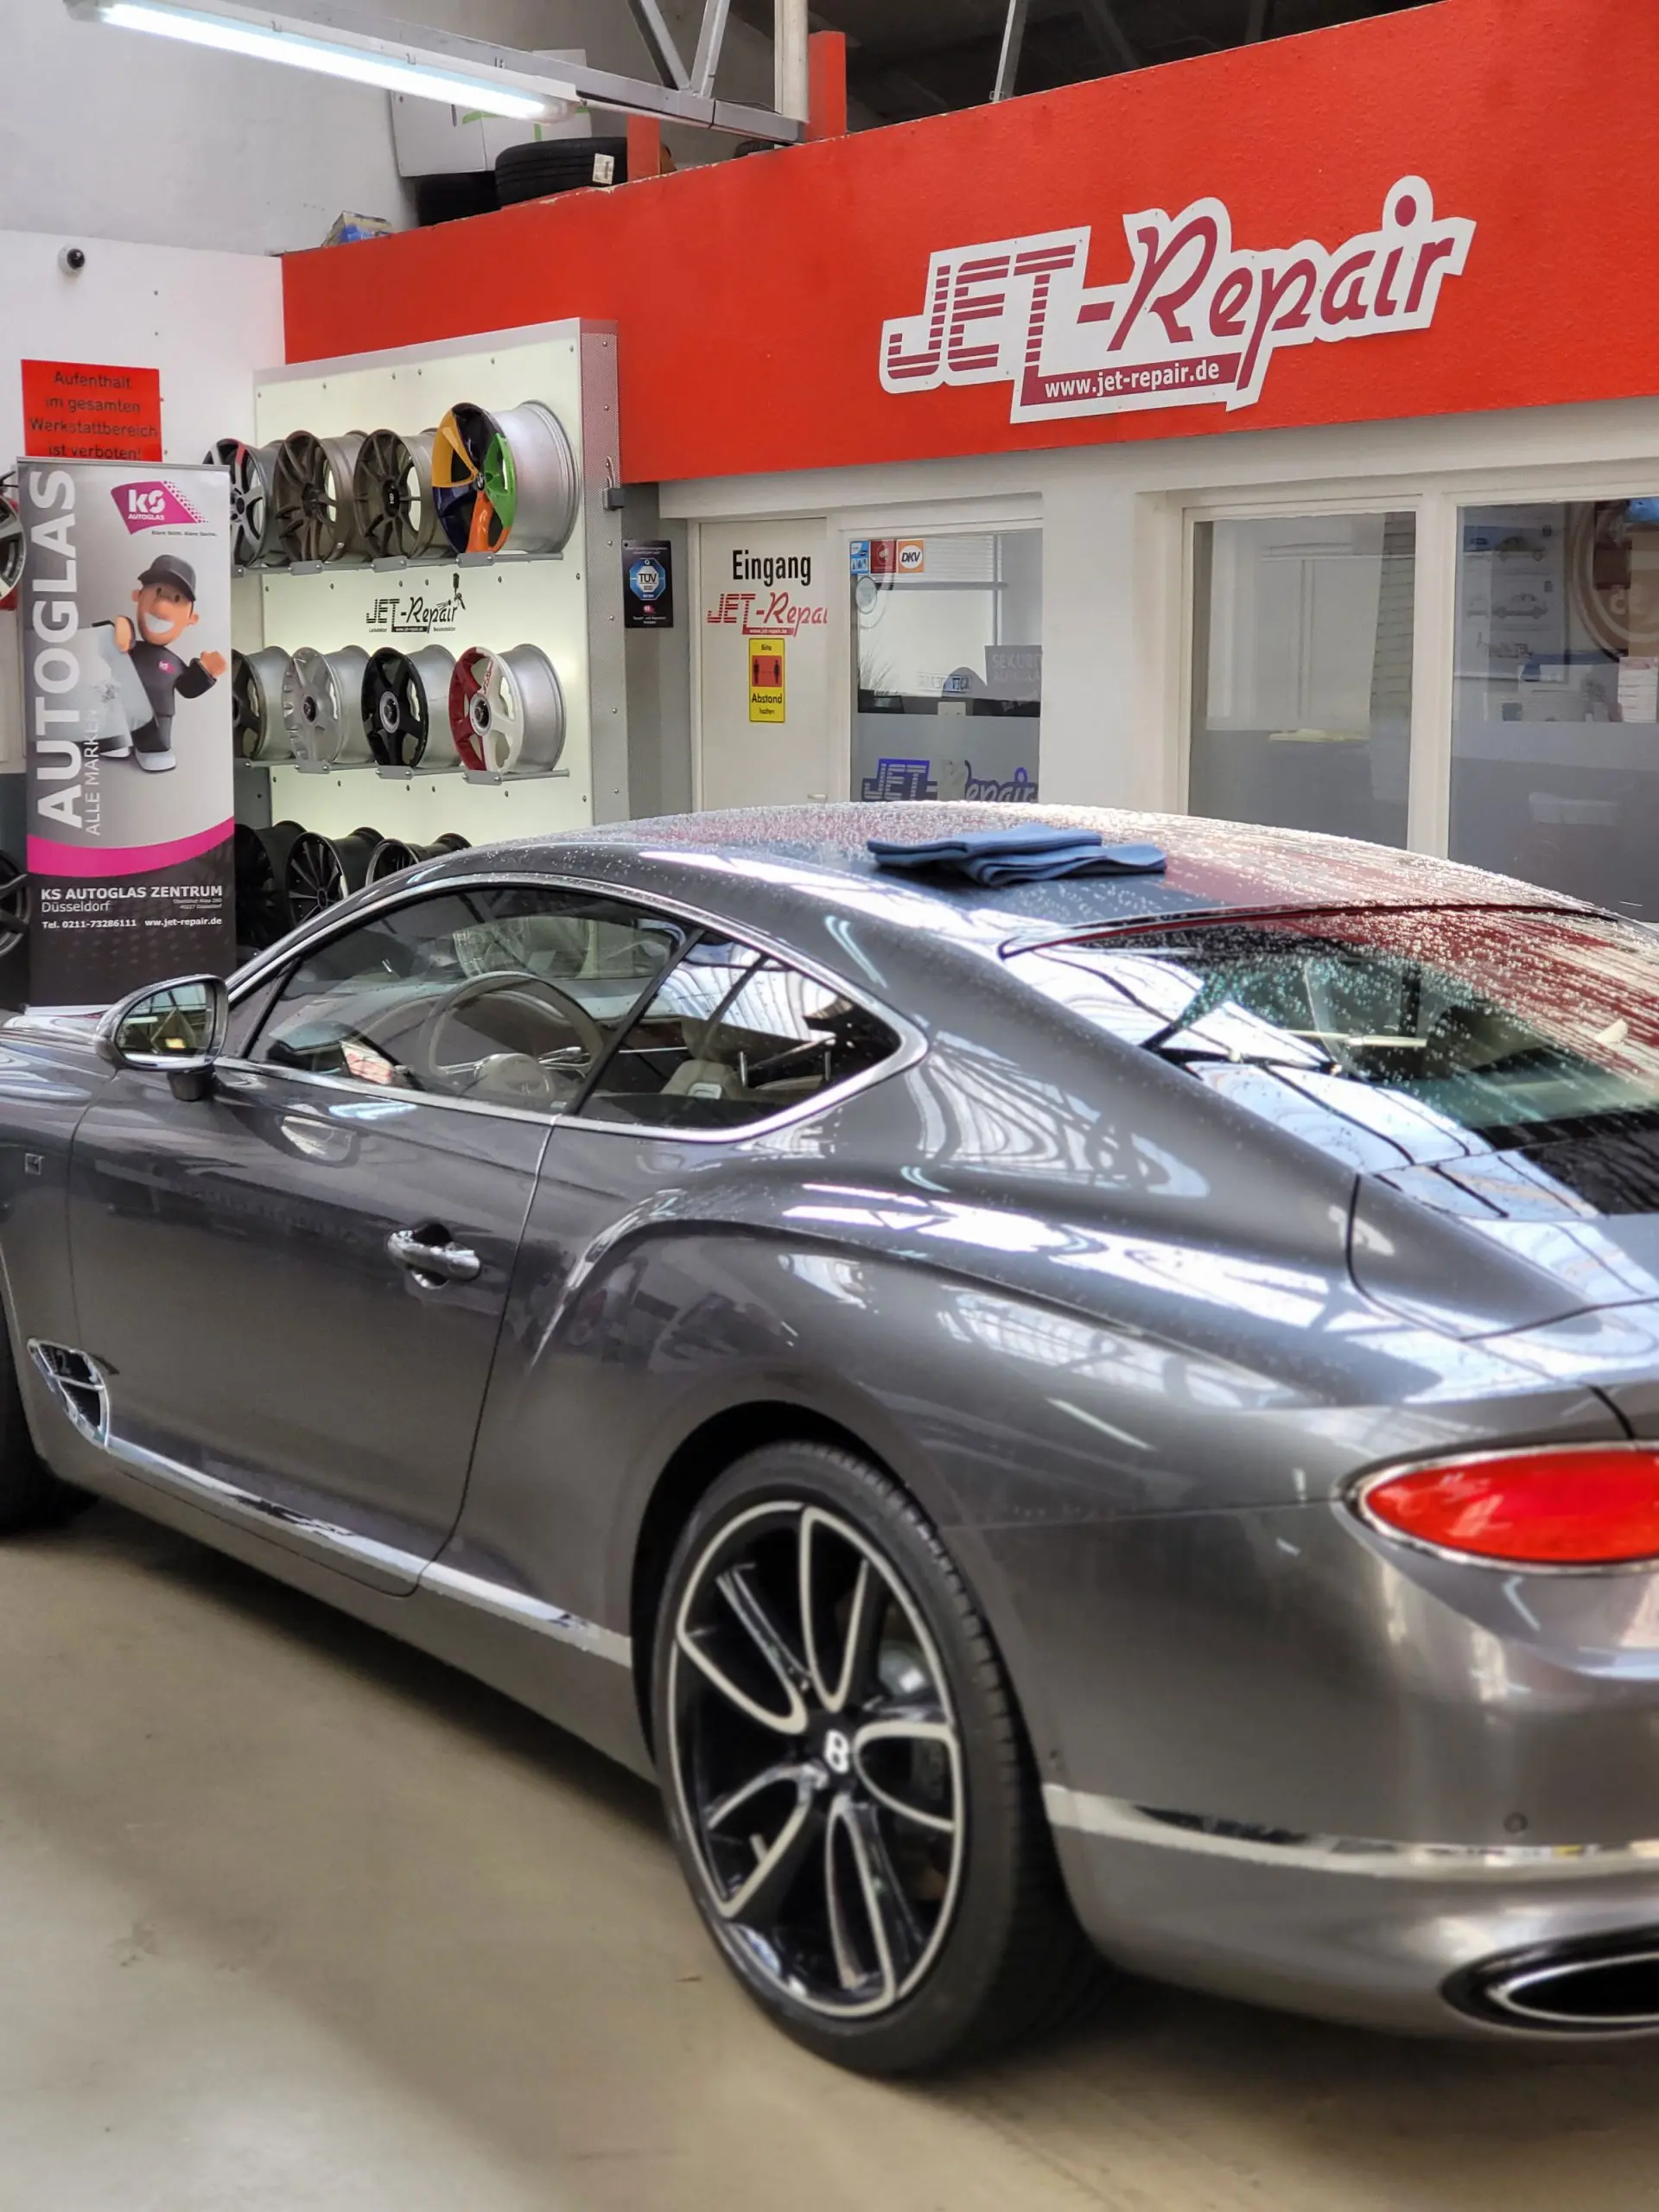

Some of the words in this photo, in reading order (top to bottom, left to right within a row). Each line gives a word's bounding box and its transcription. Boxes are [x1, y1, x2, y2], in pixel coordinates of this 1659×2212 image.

[886, 193, 1455, 394] JET-Repair
[54, 370, 132, 389] Aufenthalt
[1044, 359, 1220, 397] www.jet-repair.de
[46, 397, 64, 408] im
[67, 398, 141, 414] gesamten
[29, 417, 158, 437] Werkstattbereich
[48, 443, 69, 457] ist
[71, 444, 143, 461] verboten!
[732, 549, 811, 588] Eingang
[901, 551, 921, 563] DKV
[365, 596, 458, 633] JET-Repair
[707, 591, 829, 638] JET-Repai
[29, 470, 84, 829] AUTOGLAS
[751, 692, 783, 704] Abstand
[83, 709, 100, 786] MARKEN
[85, 791, 101, 836] ALLE
[41, 888, 62, 900] KS
[65, 887, 147, 899] AUTOGLAS
[150, 886, 223, 898] ZENTRUM
[41, 899, 111, 913] Düsseldorf
